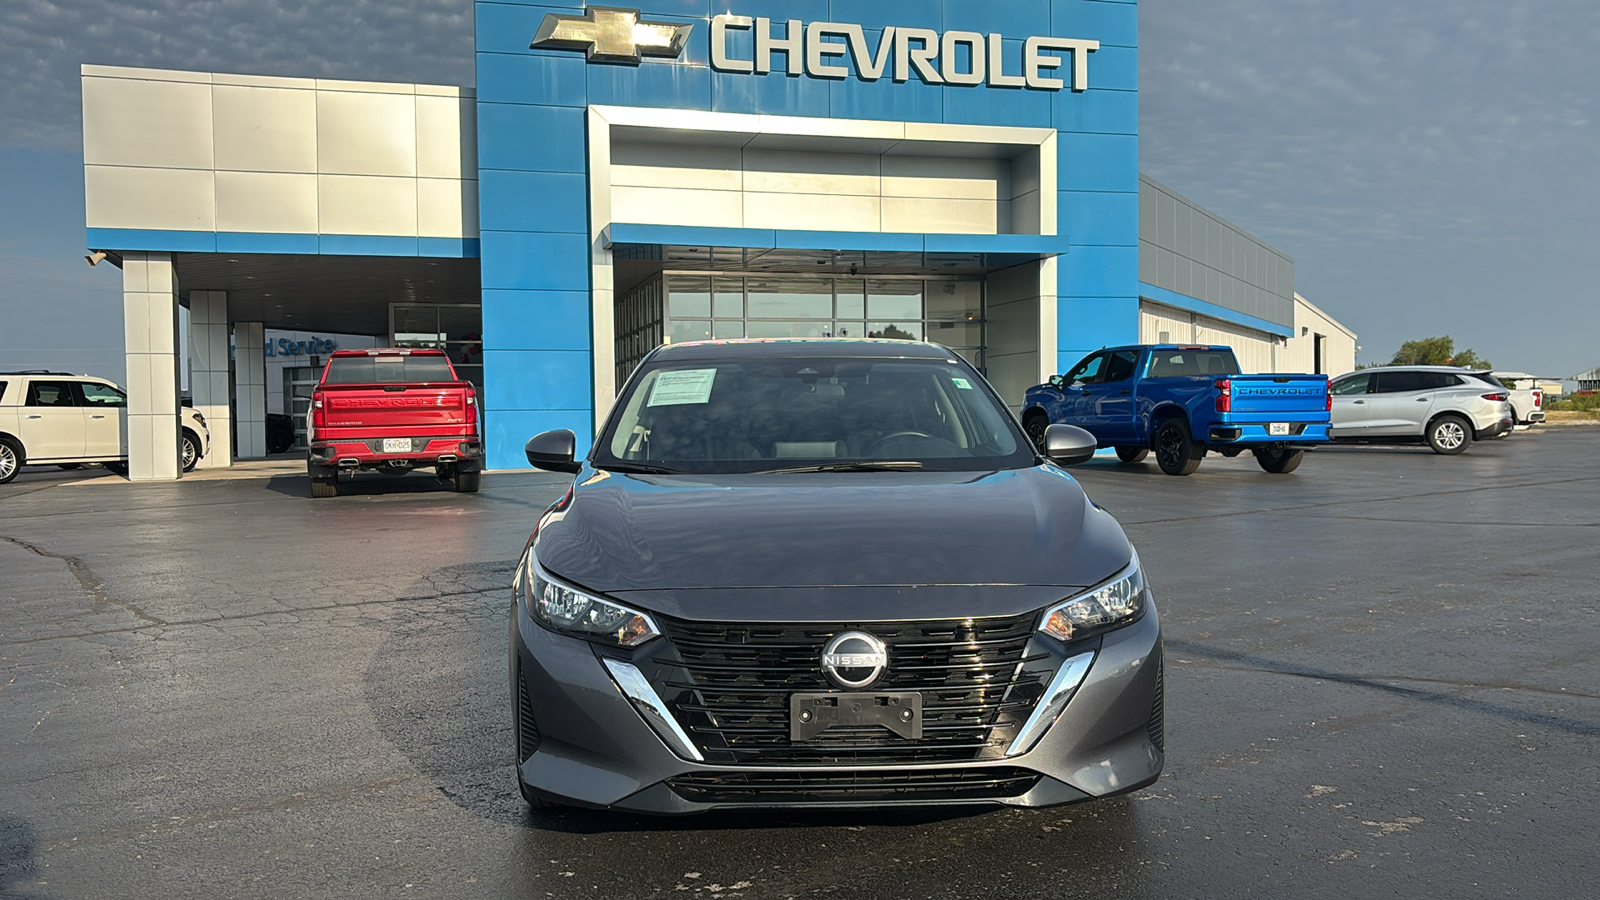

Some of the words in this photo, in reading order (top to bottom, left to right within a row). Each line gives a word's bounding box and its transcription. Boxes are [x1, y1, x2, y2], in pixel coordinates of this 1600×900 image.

[711, 14, 1100, 92] CHEVROLET
[278, 336, 334, 356] Service
[824, 656, 885, 665] NISSAN
